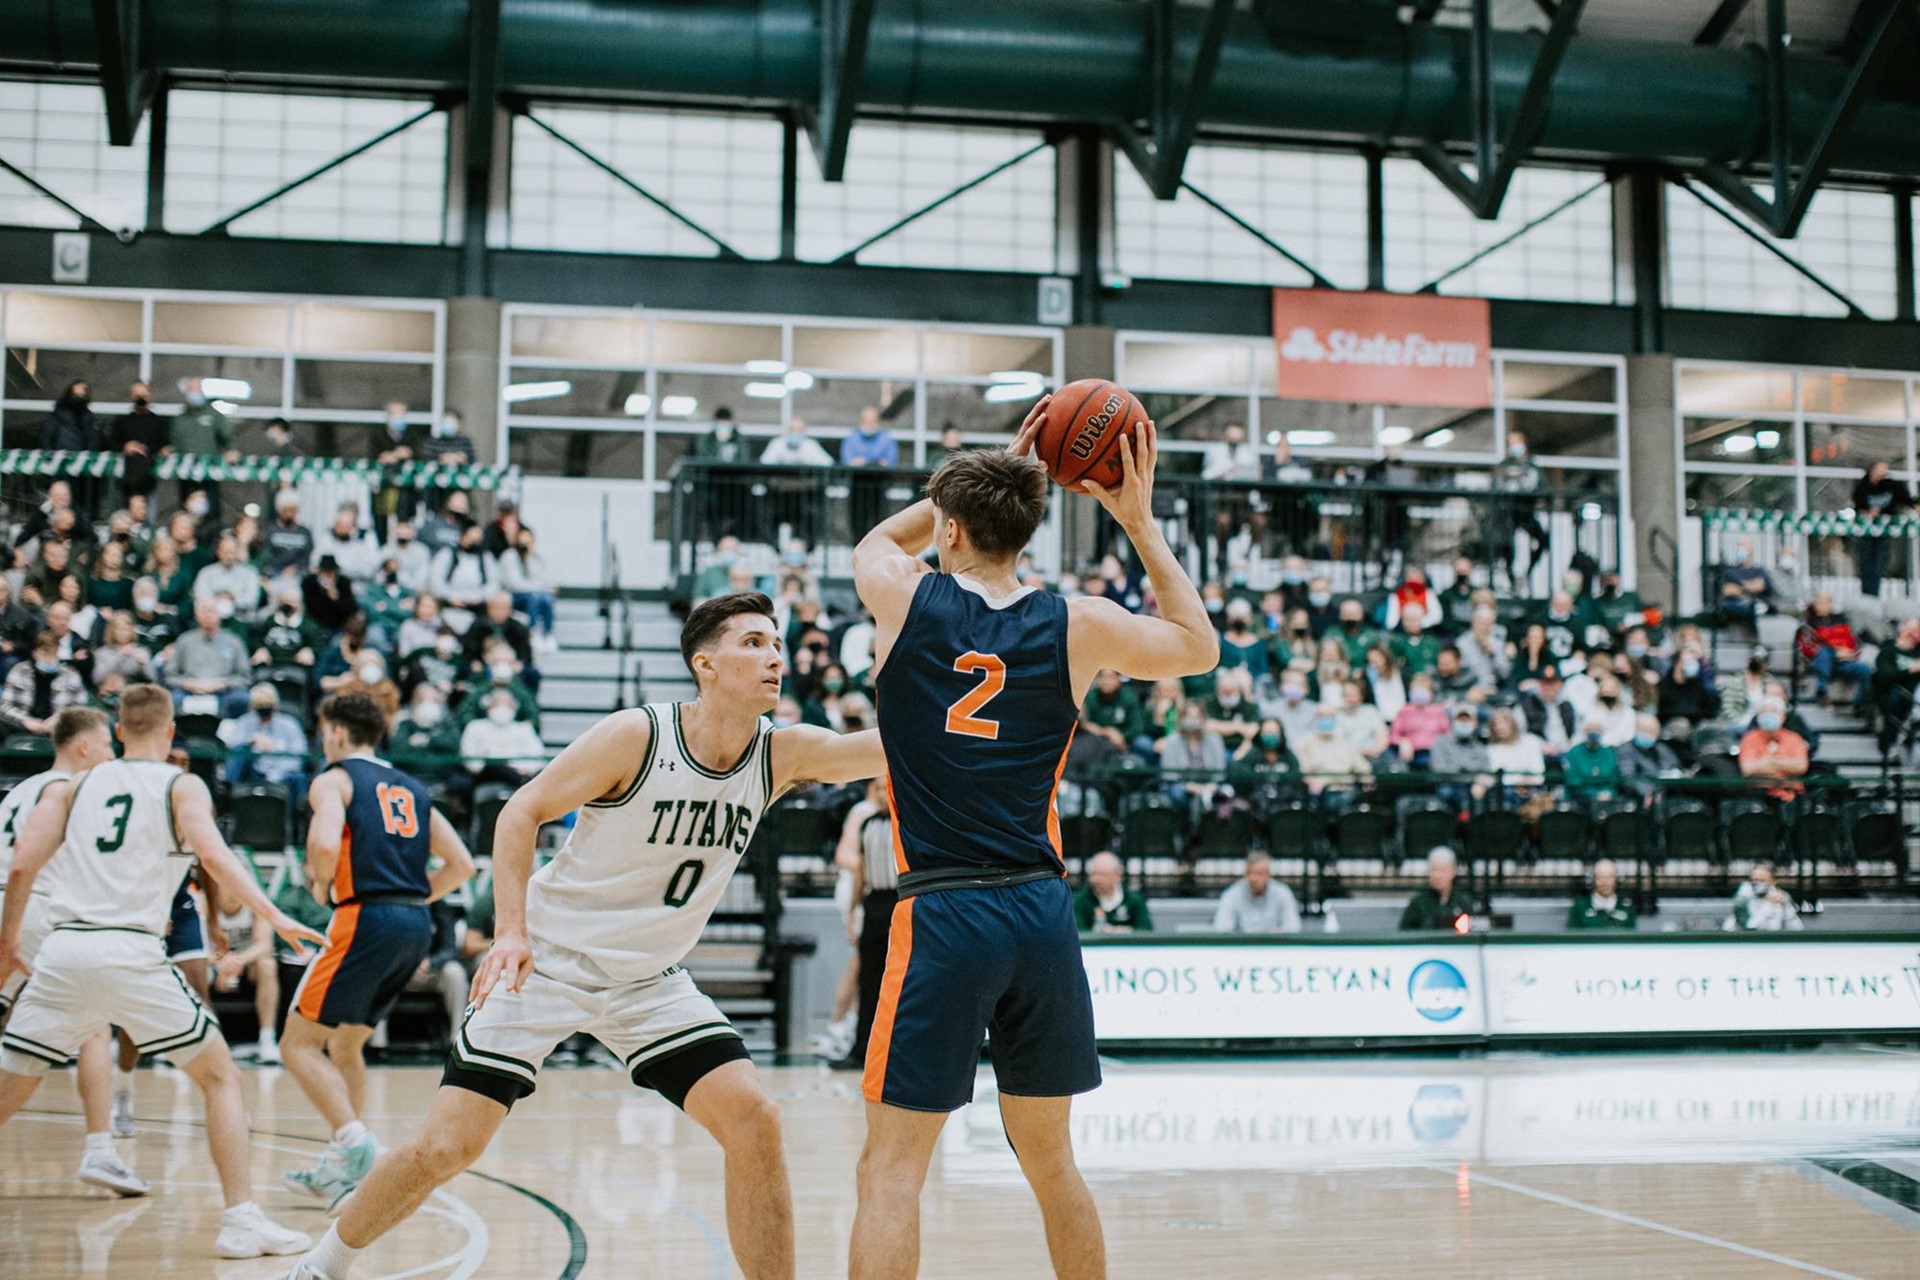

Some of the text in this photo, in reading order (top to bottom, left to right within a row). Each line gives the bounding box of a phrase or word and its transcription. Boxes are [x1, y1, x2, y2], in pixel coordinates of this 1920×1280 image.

[59, 243, 81, 272] C
[1045, 286, 1066, 314] D
[1069, 394, 1125, 460] Wilson
[945, 650, 1006, 740] 2
[96, 792, 133, 853] 3
[375, 781, 419, 838] 13
[646, 799, 752, 855] TITANS
[663, 859, 705, 908] 0
[1094, 967, 1391, 994] INOIS WESLEYAN
[1576, 976, 1893, 1000] HOME OF THE TITANS
